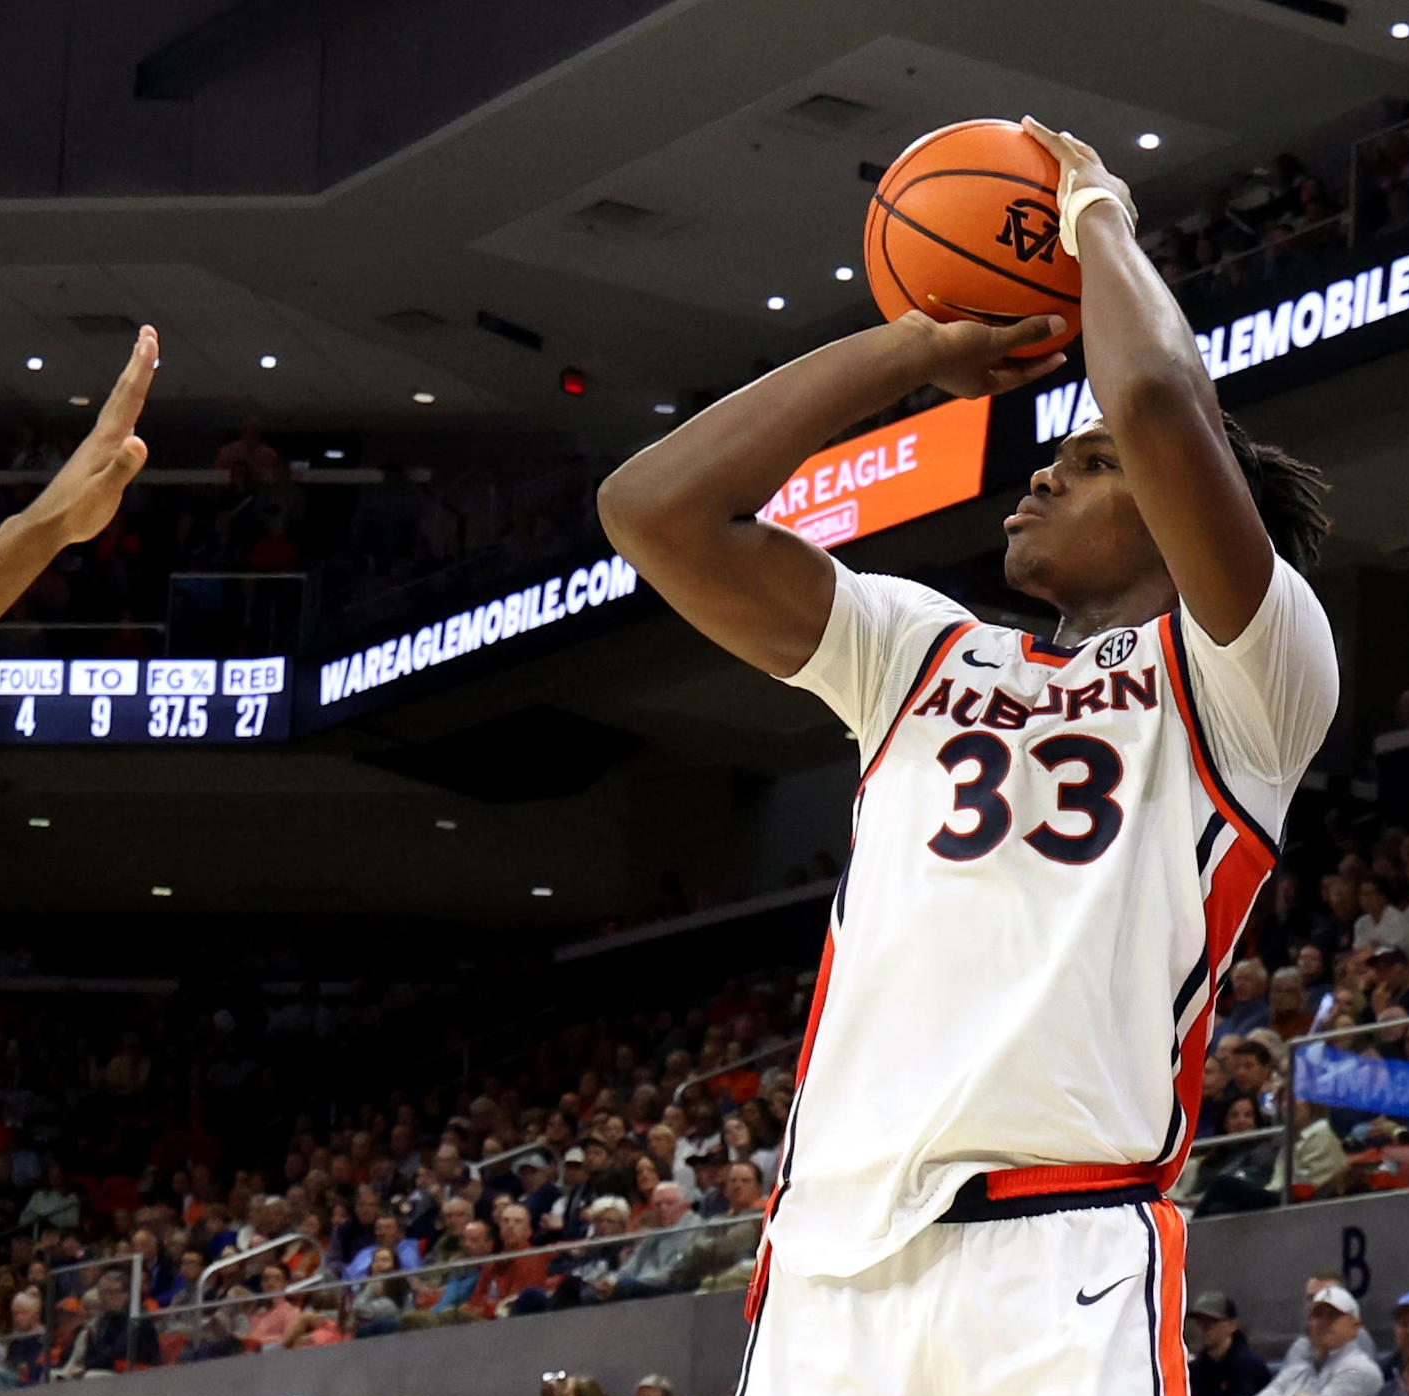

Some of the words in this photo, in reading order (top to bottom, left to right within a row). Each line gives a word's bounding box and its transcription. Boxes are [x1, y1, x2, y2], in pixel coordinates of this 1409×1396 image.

[814, 433, 919, 505] EAGLE
[320, 554, 638, 706] WAREAGLEMOBILE.COM
[1099, 631, 1135, 667] SEC
[0, 668, 59, 689] FOULS
[85, 669, 121, 689] TO
[152, 669, 183, 689] FG
[230, 666, 278, 688] REB
[912, 664, 1159, 729] AUBURN
[15, 696, 36, 736] 4
[91, 696, 111, 737] 9
[148, 696, 208, 737] 37.5
[234, 694, 268, 737] 27
[927, 730, 1124, 865] 33
[1342, 1226, 1372, 1299] B
